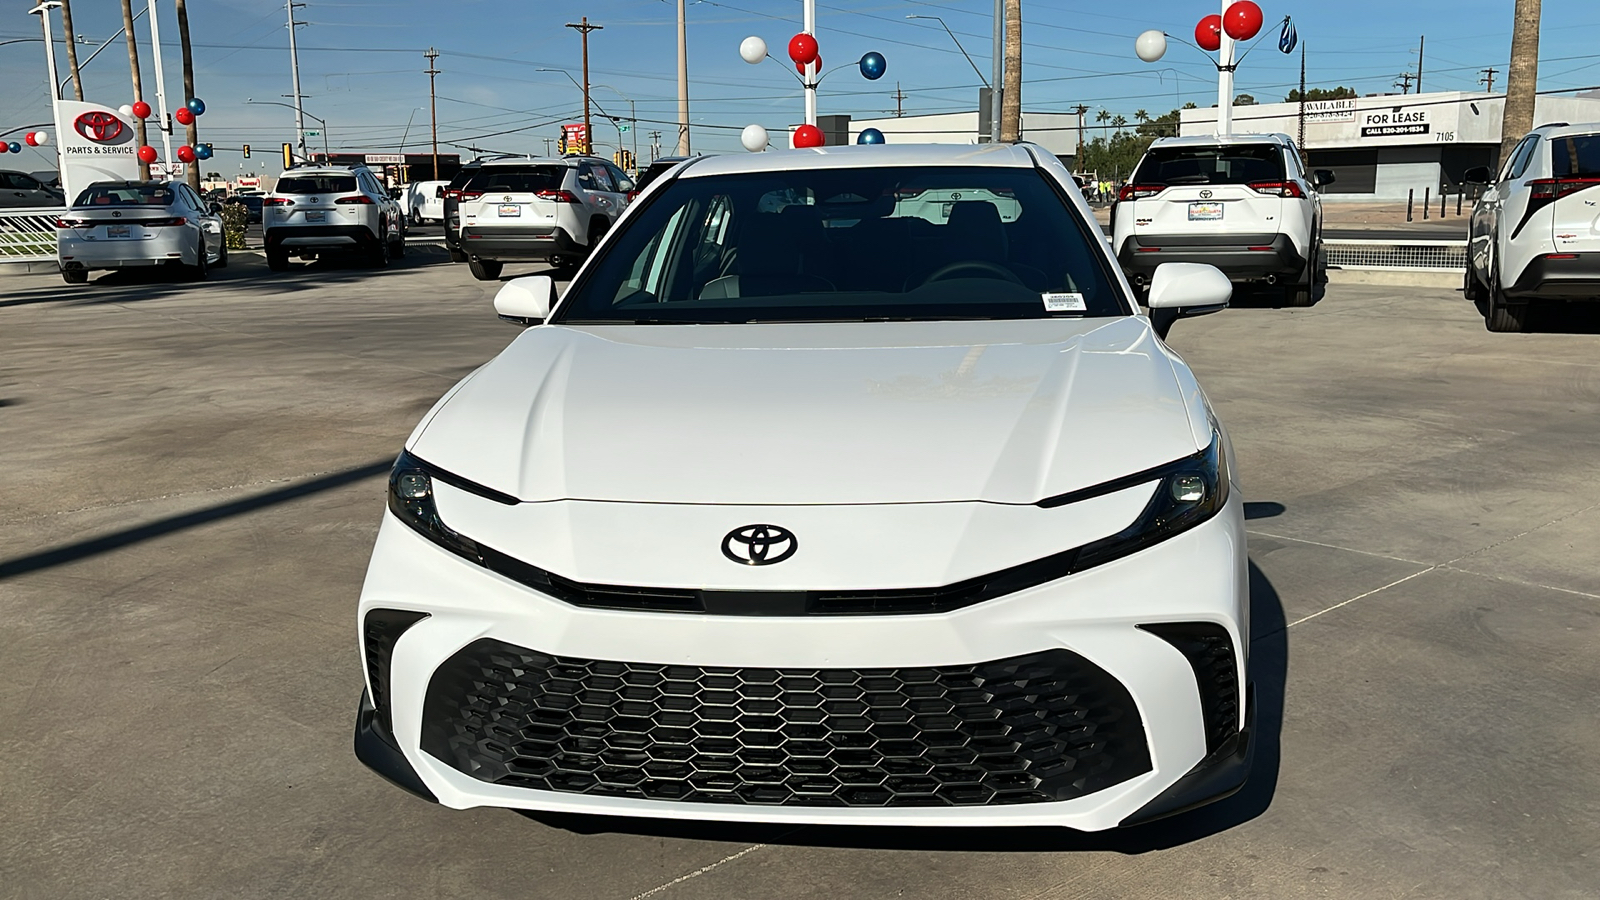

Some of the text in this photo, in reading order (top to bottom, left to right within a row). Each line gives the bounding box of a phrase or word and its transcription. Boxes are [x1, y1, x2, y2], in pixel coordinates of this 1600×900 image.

[1366, 114, 1388, 125] FOR
[1392, 112, 1425, 123] LEASE
[1436, 132, 1454, 141] 7105
[66, 146, 134, 154] PARTS & SERVICE
